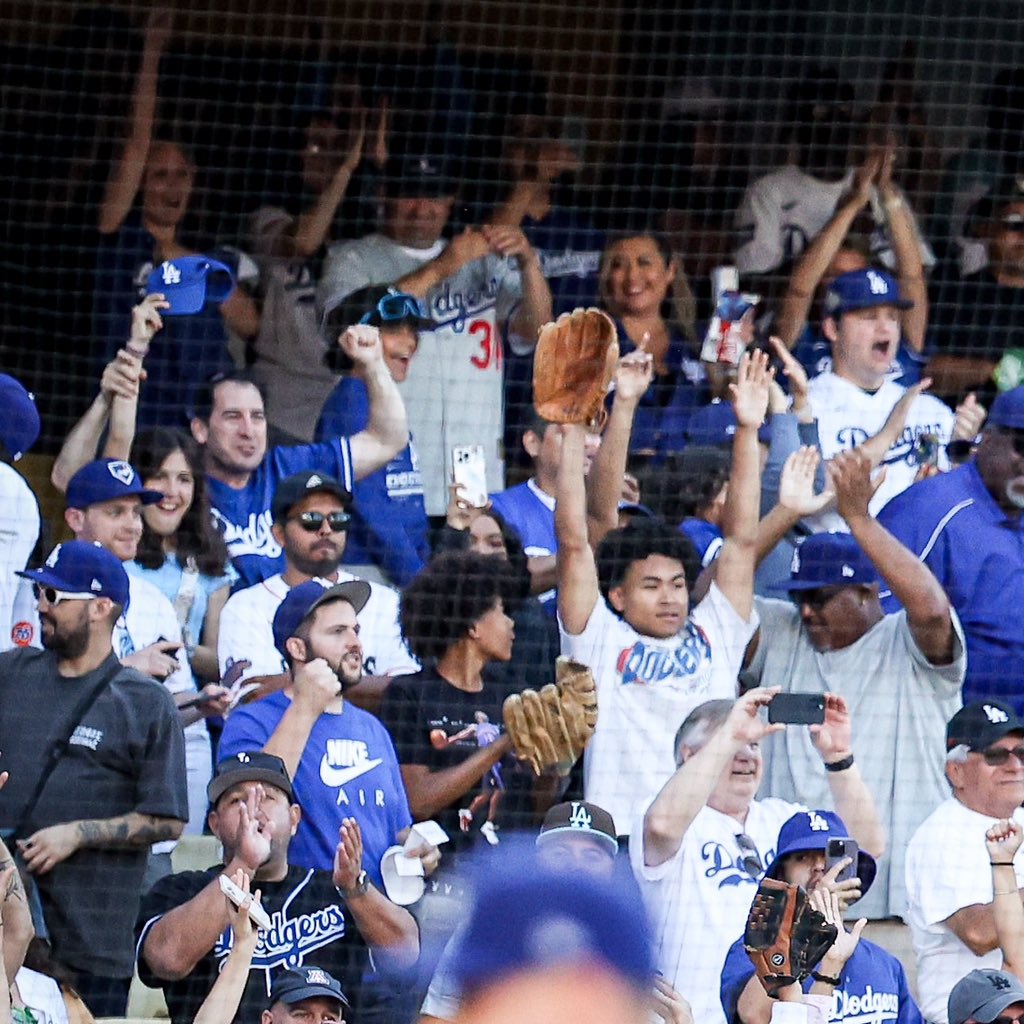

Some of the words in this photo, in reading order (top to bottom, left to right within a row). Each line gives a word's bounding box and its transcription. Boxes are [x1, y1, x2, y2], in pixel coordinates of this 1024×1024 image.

[327, 738, 370, 766] NIKE
[337, 787, 386, 807] AIR
[570, 802, 591, 829] LA
[808, 811, 830, 831] LA
[987, 975, 1011, 991] LA
